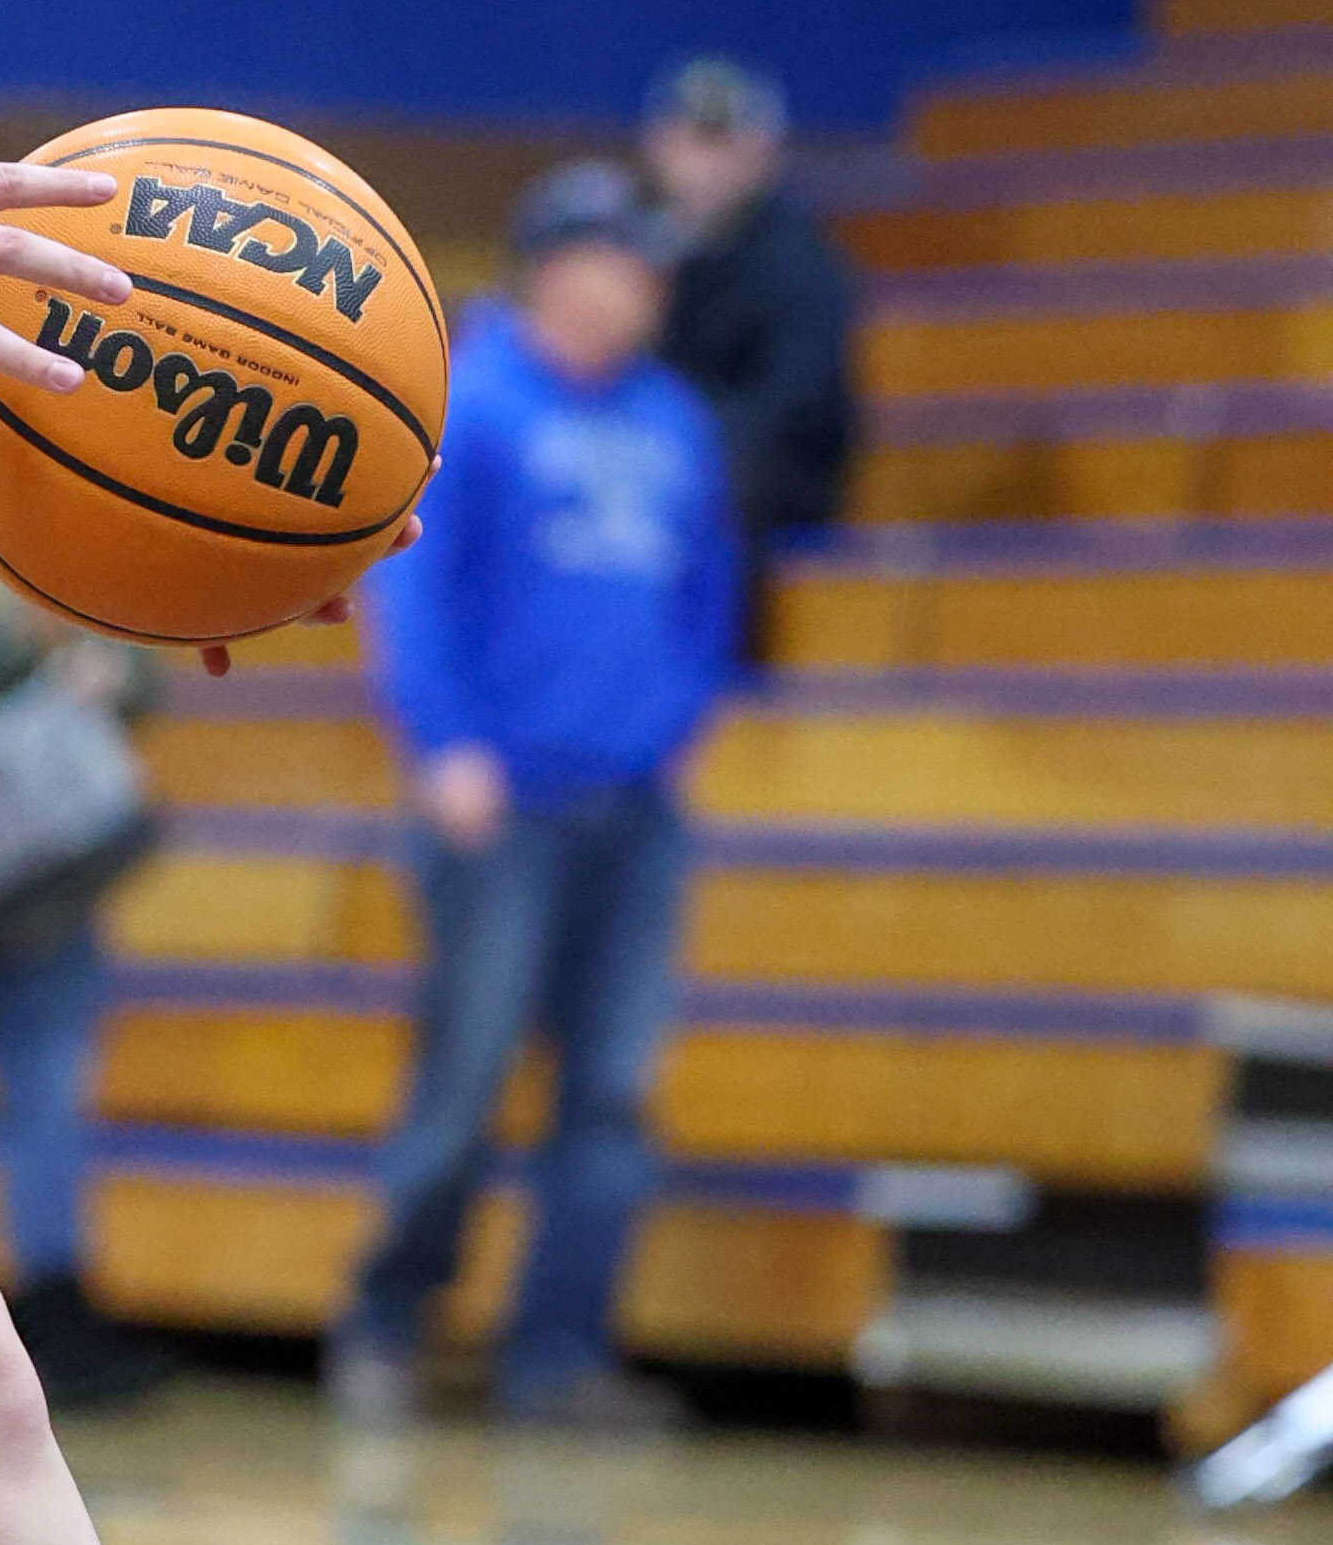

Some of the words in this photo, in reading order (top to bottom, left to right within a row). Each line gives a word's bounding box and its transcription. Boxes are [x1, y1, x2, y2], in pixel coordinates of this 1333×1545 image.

[123, 175, 383, 324] NCAA
[135, 311, 177, 338] BALL
[181, 332, 231, 360] GAME
[236, 353, 301, 387] INDOOR
[35, 295, 360, 509] Wilson
